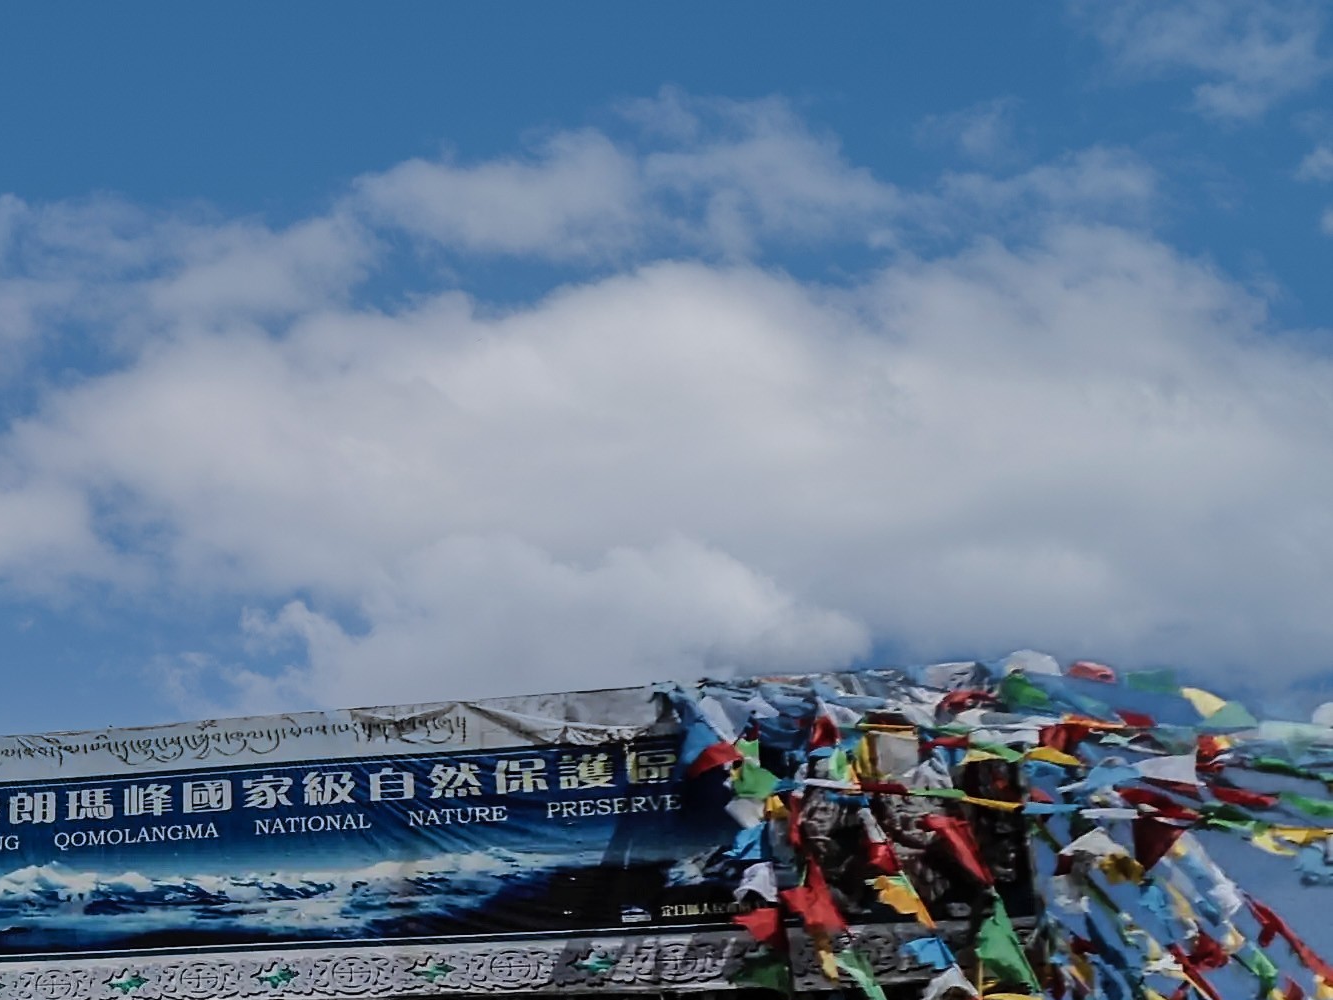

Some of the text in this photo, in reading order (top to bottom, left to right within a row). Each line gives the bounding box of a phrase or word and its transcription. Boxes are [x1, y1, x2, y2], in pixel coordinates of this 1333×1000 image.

[54, 822, 220, 851] QOMOLANGMA
[255, 813, 372, 836] NATIONAL
[408, 805, 508, 828] NATURE
[546, 794, 682, 820] PRESERVE
